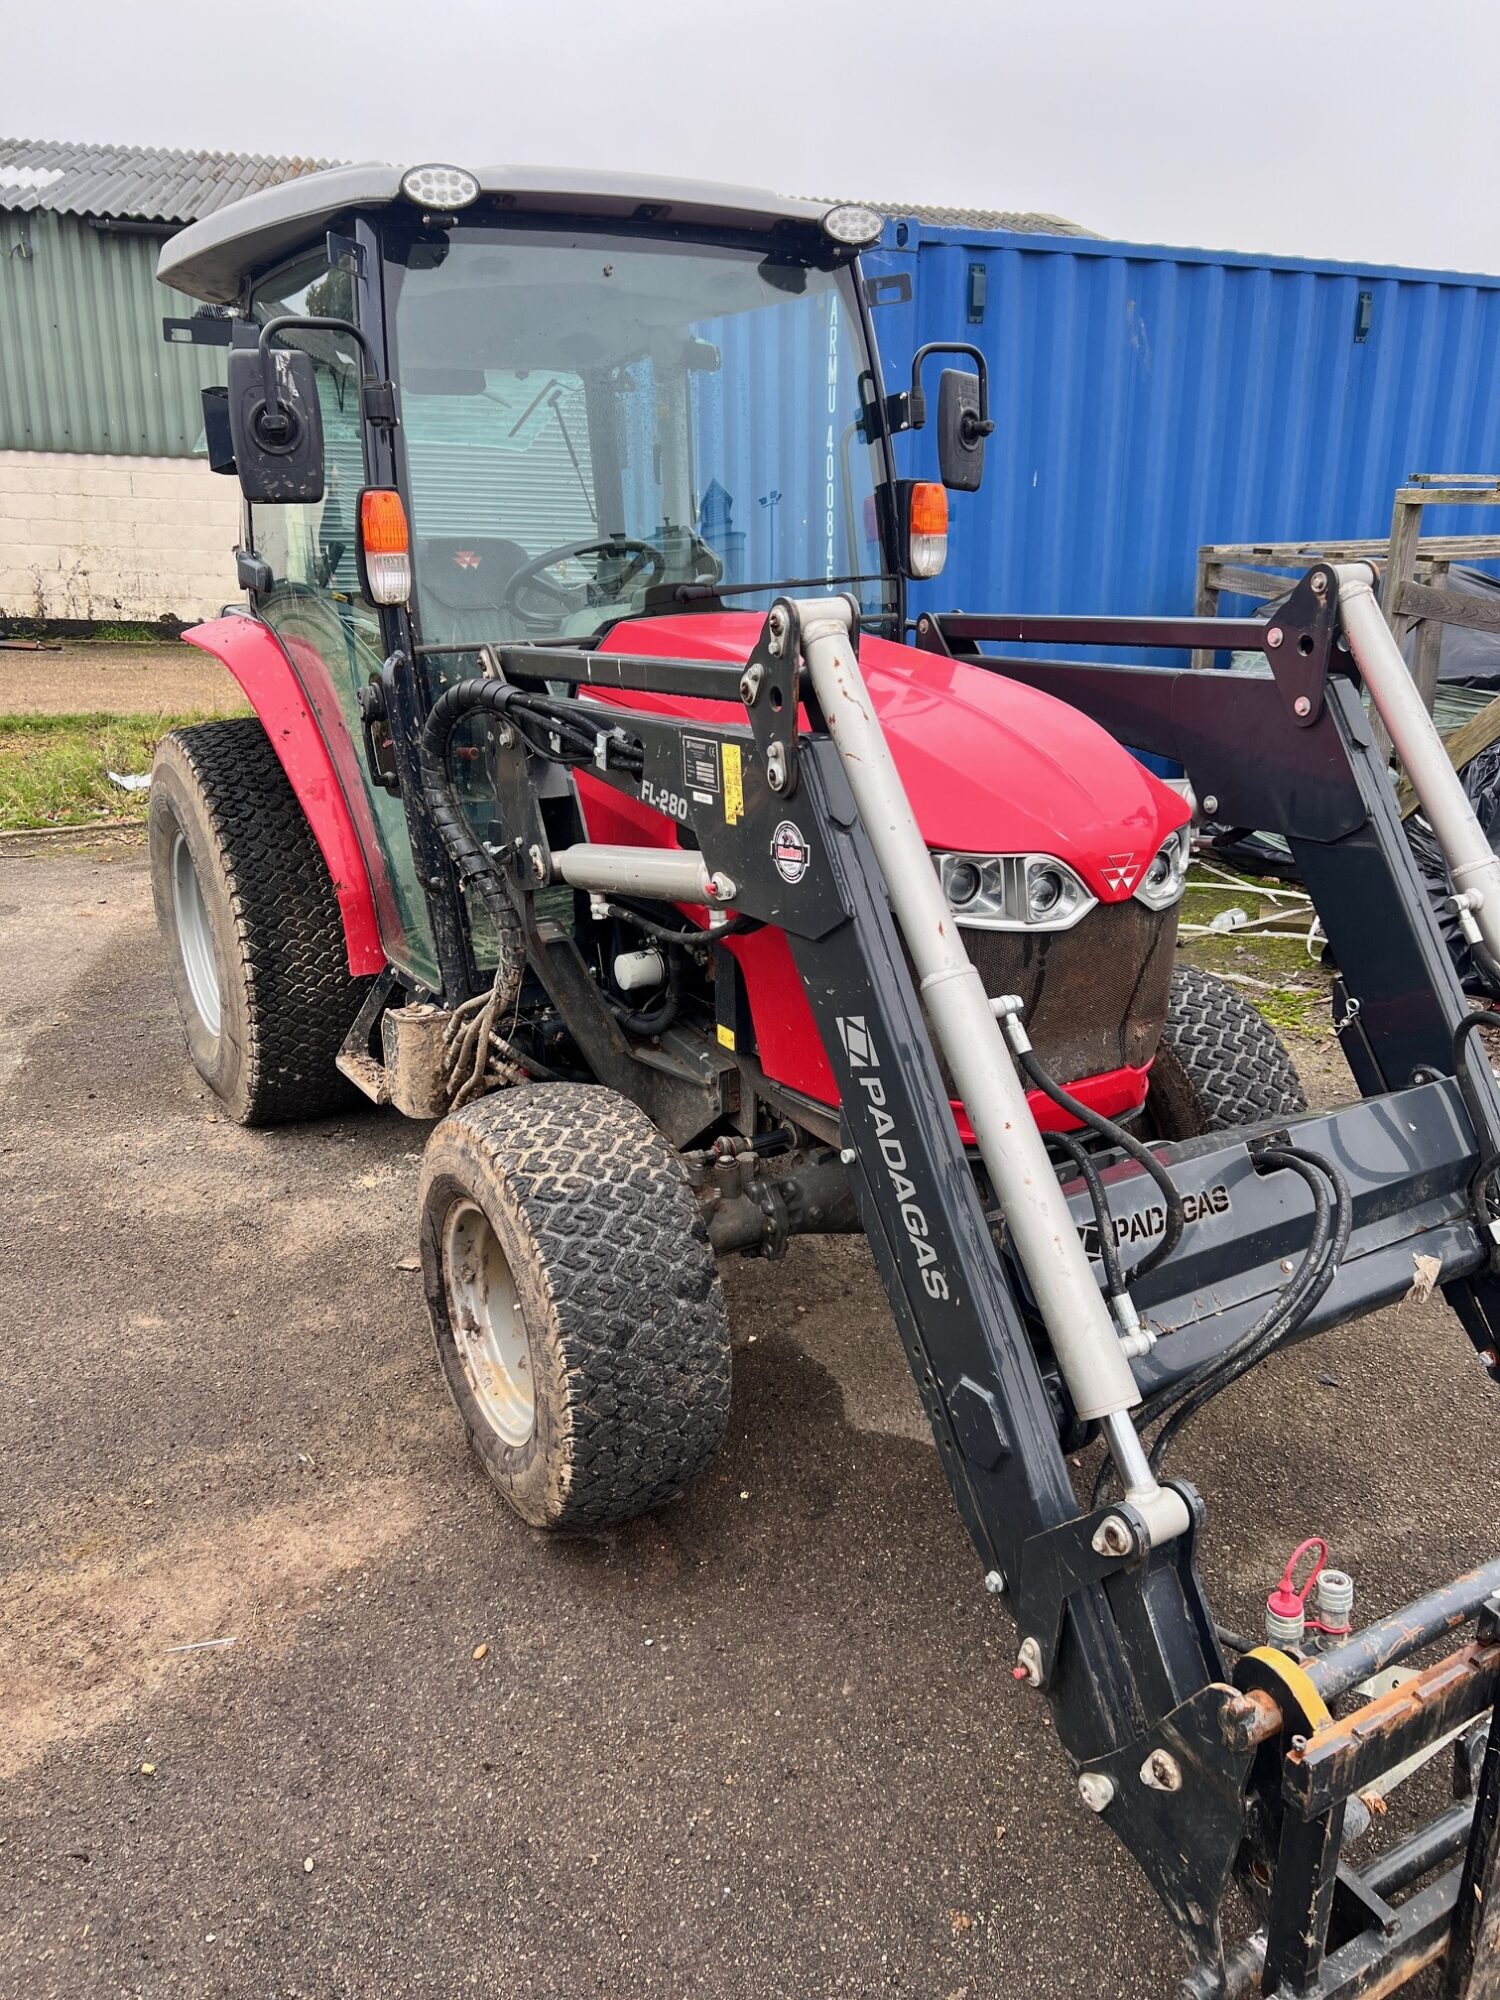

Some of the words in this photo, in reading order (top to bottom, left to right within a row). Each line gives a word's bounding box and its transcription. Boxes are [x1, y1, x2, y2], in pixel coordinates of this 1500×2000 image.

[827, 295, 838, 414] ARMU
[641, 779, 688, 820] FL-280
[859, 1077, 949, 1300] PADAGAS
[1112, 1185, 1230, 1248] PADGAS
